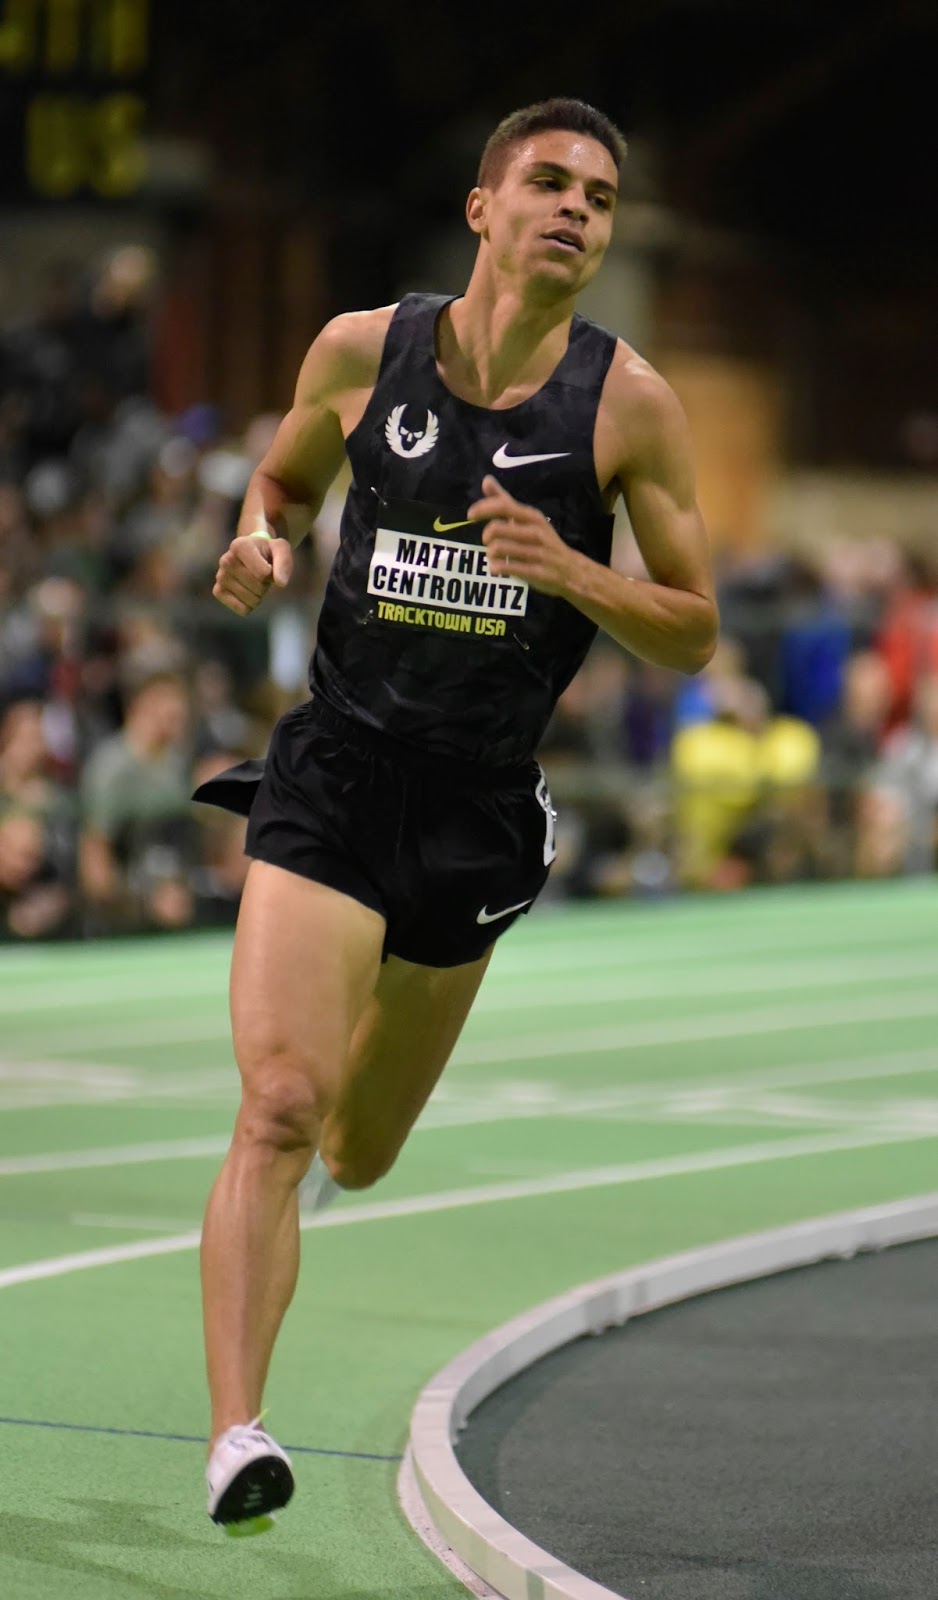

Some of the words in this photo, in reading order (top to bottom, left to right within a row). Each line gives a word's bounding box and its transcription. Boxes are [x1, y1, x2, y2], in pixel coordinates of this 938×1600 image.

[396, 538, 511, 578] MATTHE
[373, 565, 525, 610] CENTROWITZ
[377, 601, 471, 633] TRACKTOWN
[475, 617, 507, 636] USA
